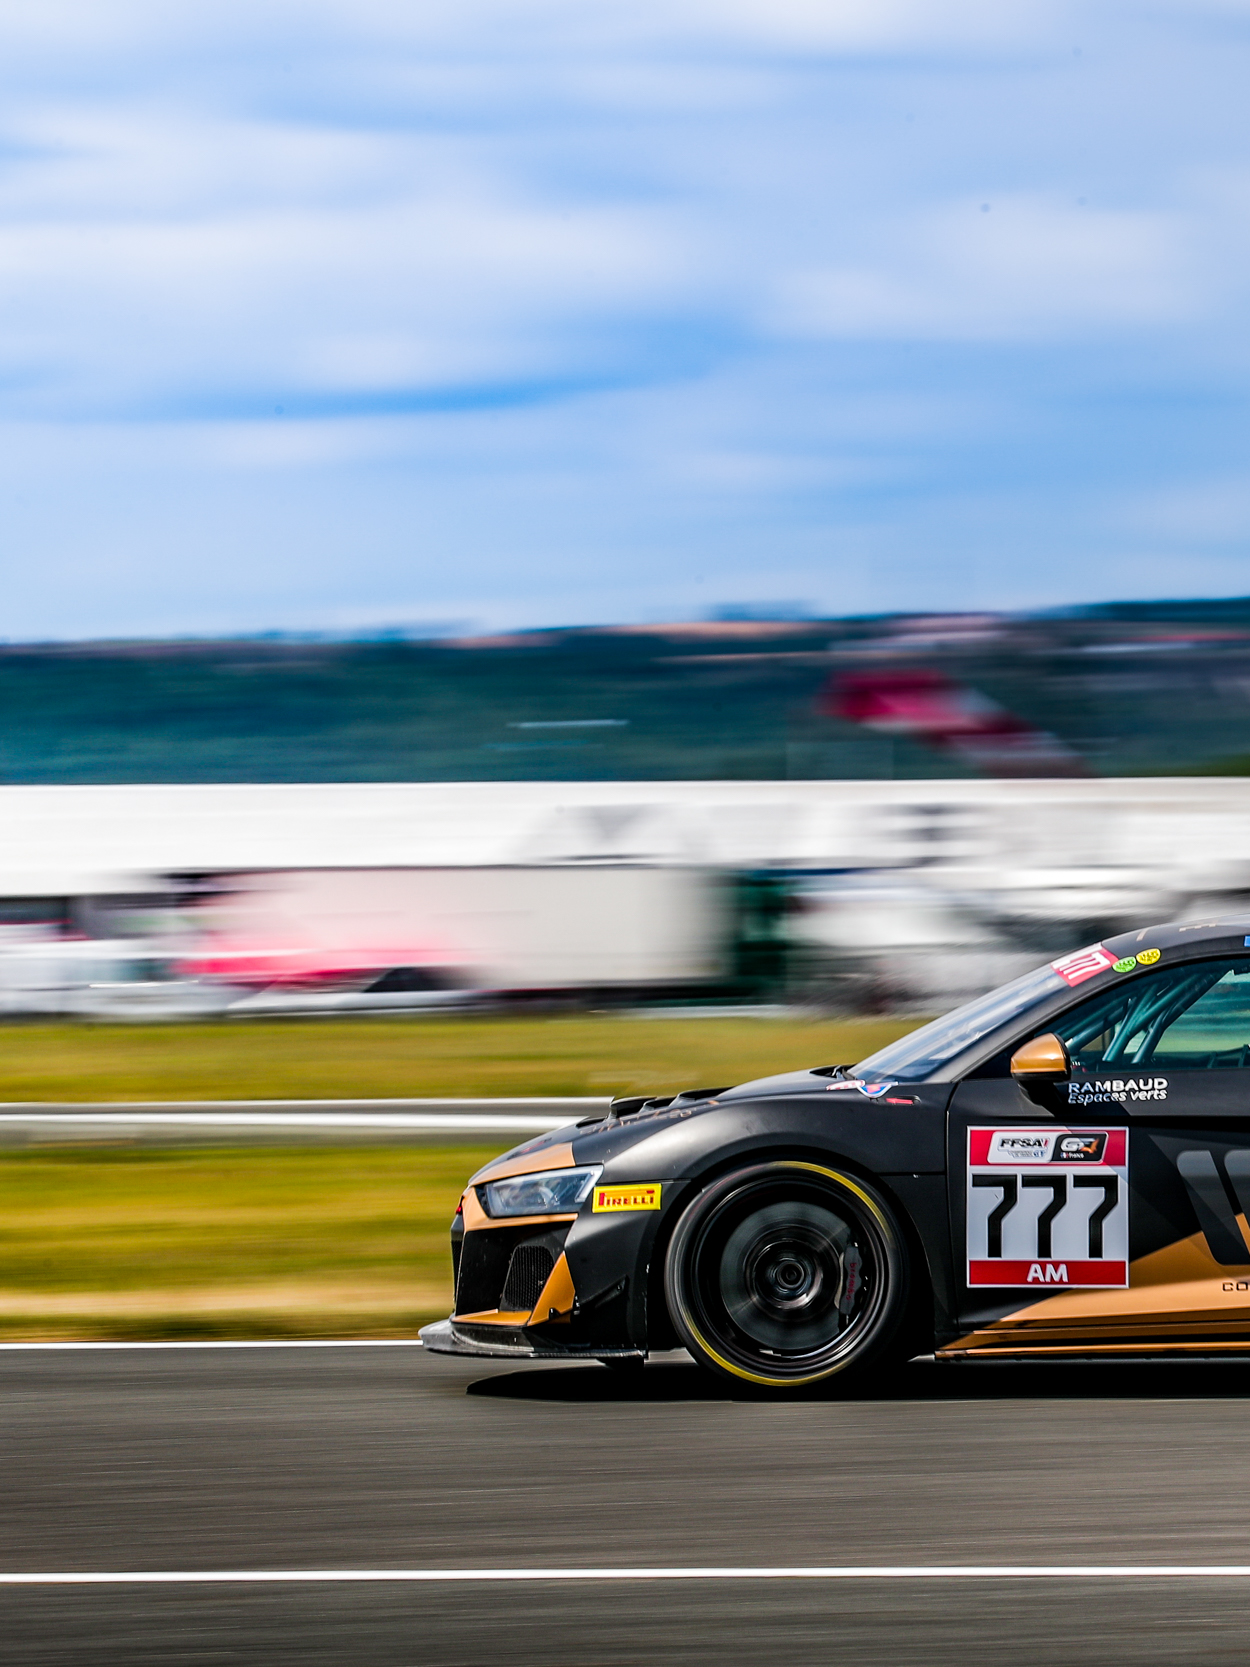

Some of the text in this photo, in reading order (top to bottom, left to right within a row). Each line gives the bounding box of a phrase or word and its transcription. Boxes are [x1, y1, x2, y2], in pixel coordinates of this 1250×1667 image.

[1068, 1077, 1169, 1094] RAMBAUD
[1068, 1089, 1168, 1106] Espaces verts
[598, 1188, 655, 1206] PIRELLI
[971, 1174, 1119, 1259] 777
[1026, 1263, 1069, 1283] AM
